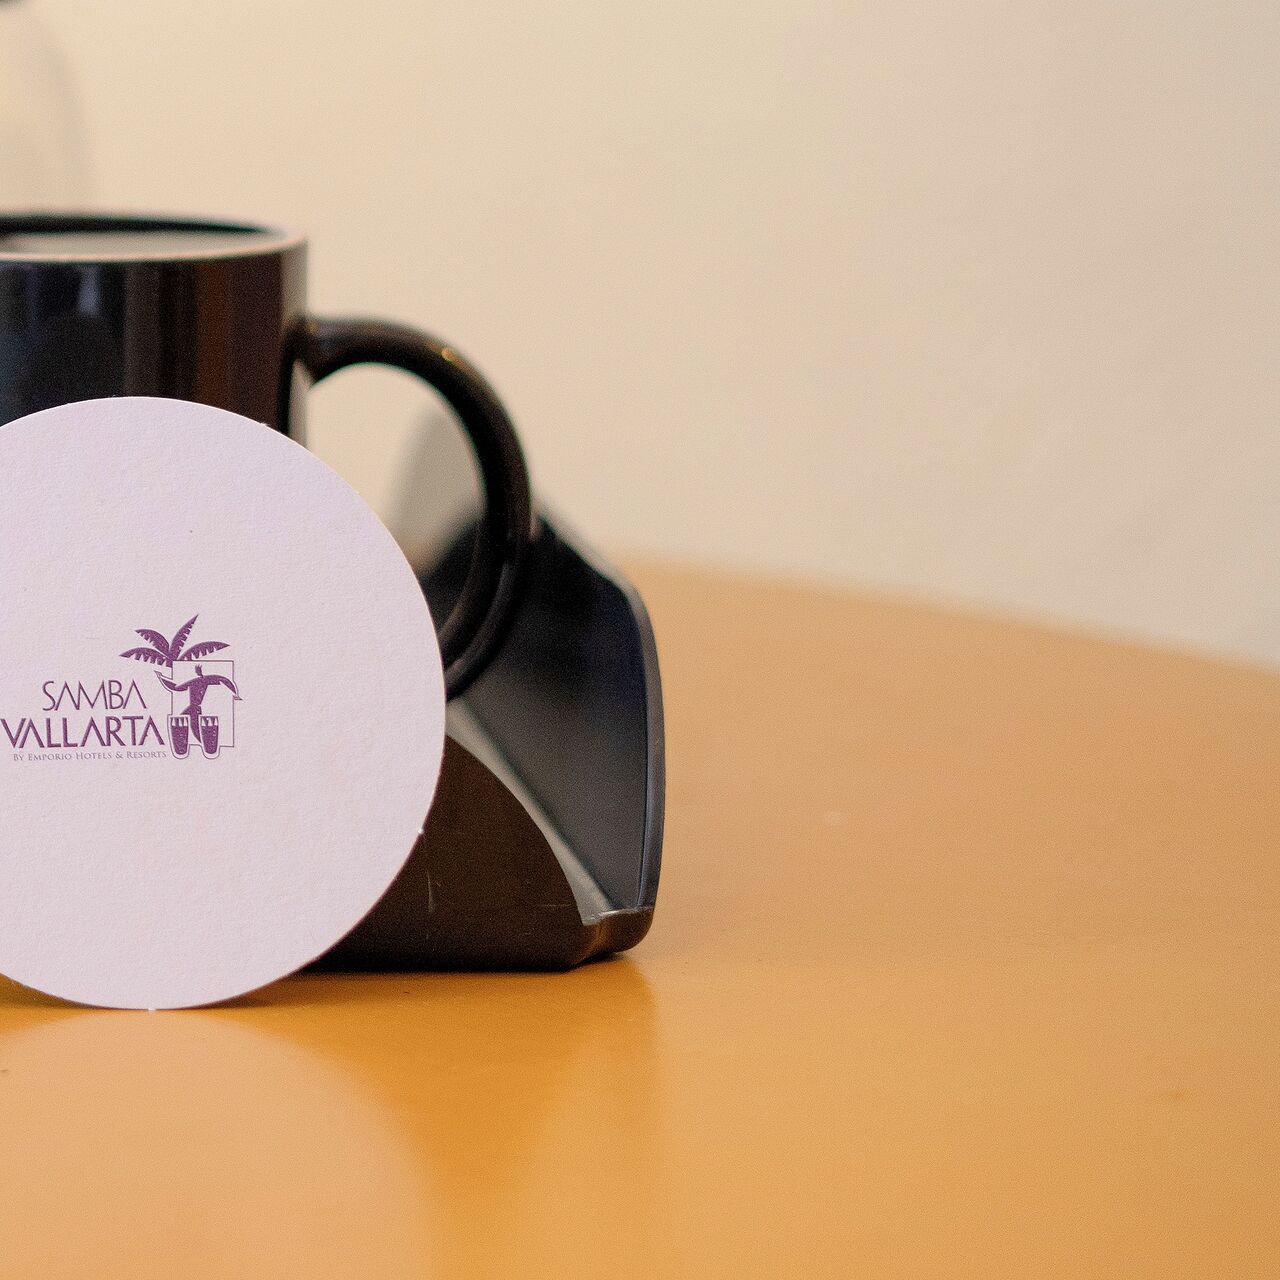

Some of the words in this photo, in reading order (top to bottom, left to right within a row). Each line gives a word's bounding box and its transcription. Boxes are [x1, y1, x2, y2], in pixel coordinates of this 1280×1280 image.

[42, 679, 147, 711] SAMBA
[0, 716, 165, 748] VALLARTA
[76, 751, 112, 761] HOTELS
[116, 751, 124, 760] &
[126, 750, 167, 760] RESORTS
